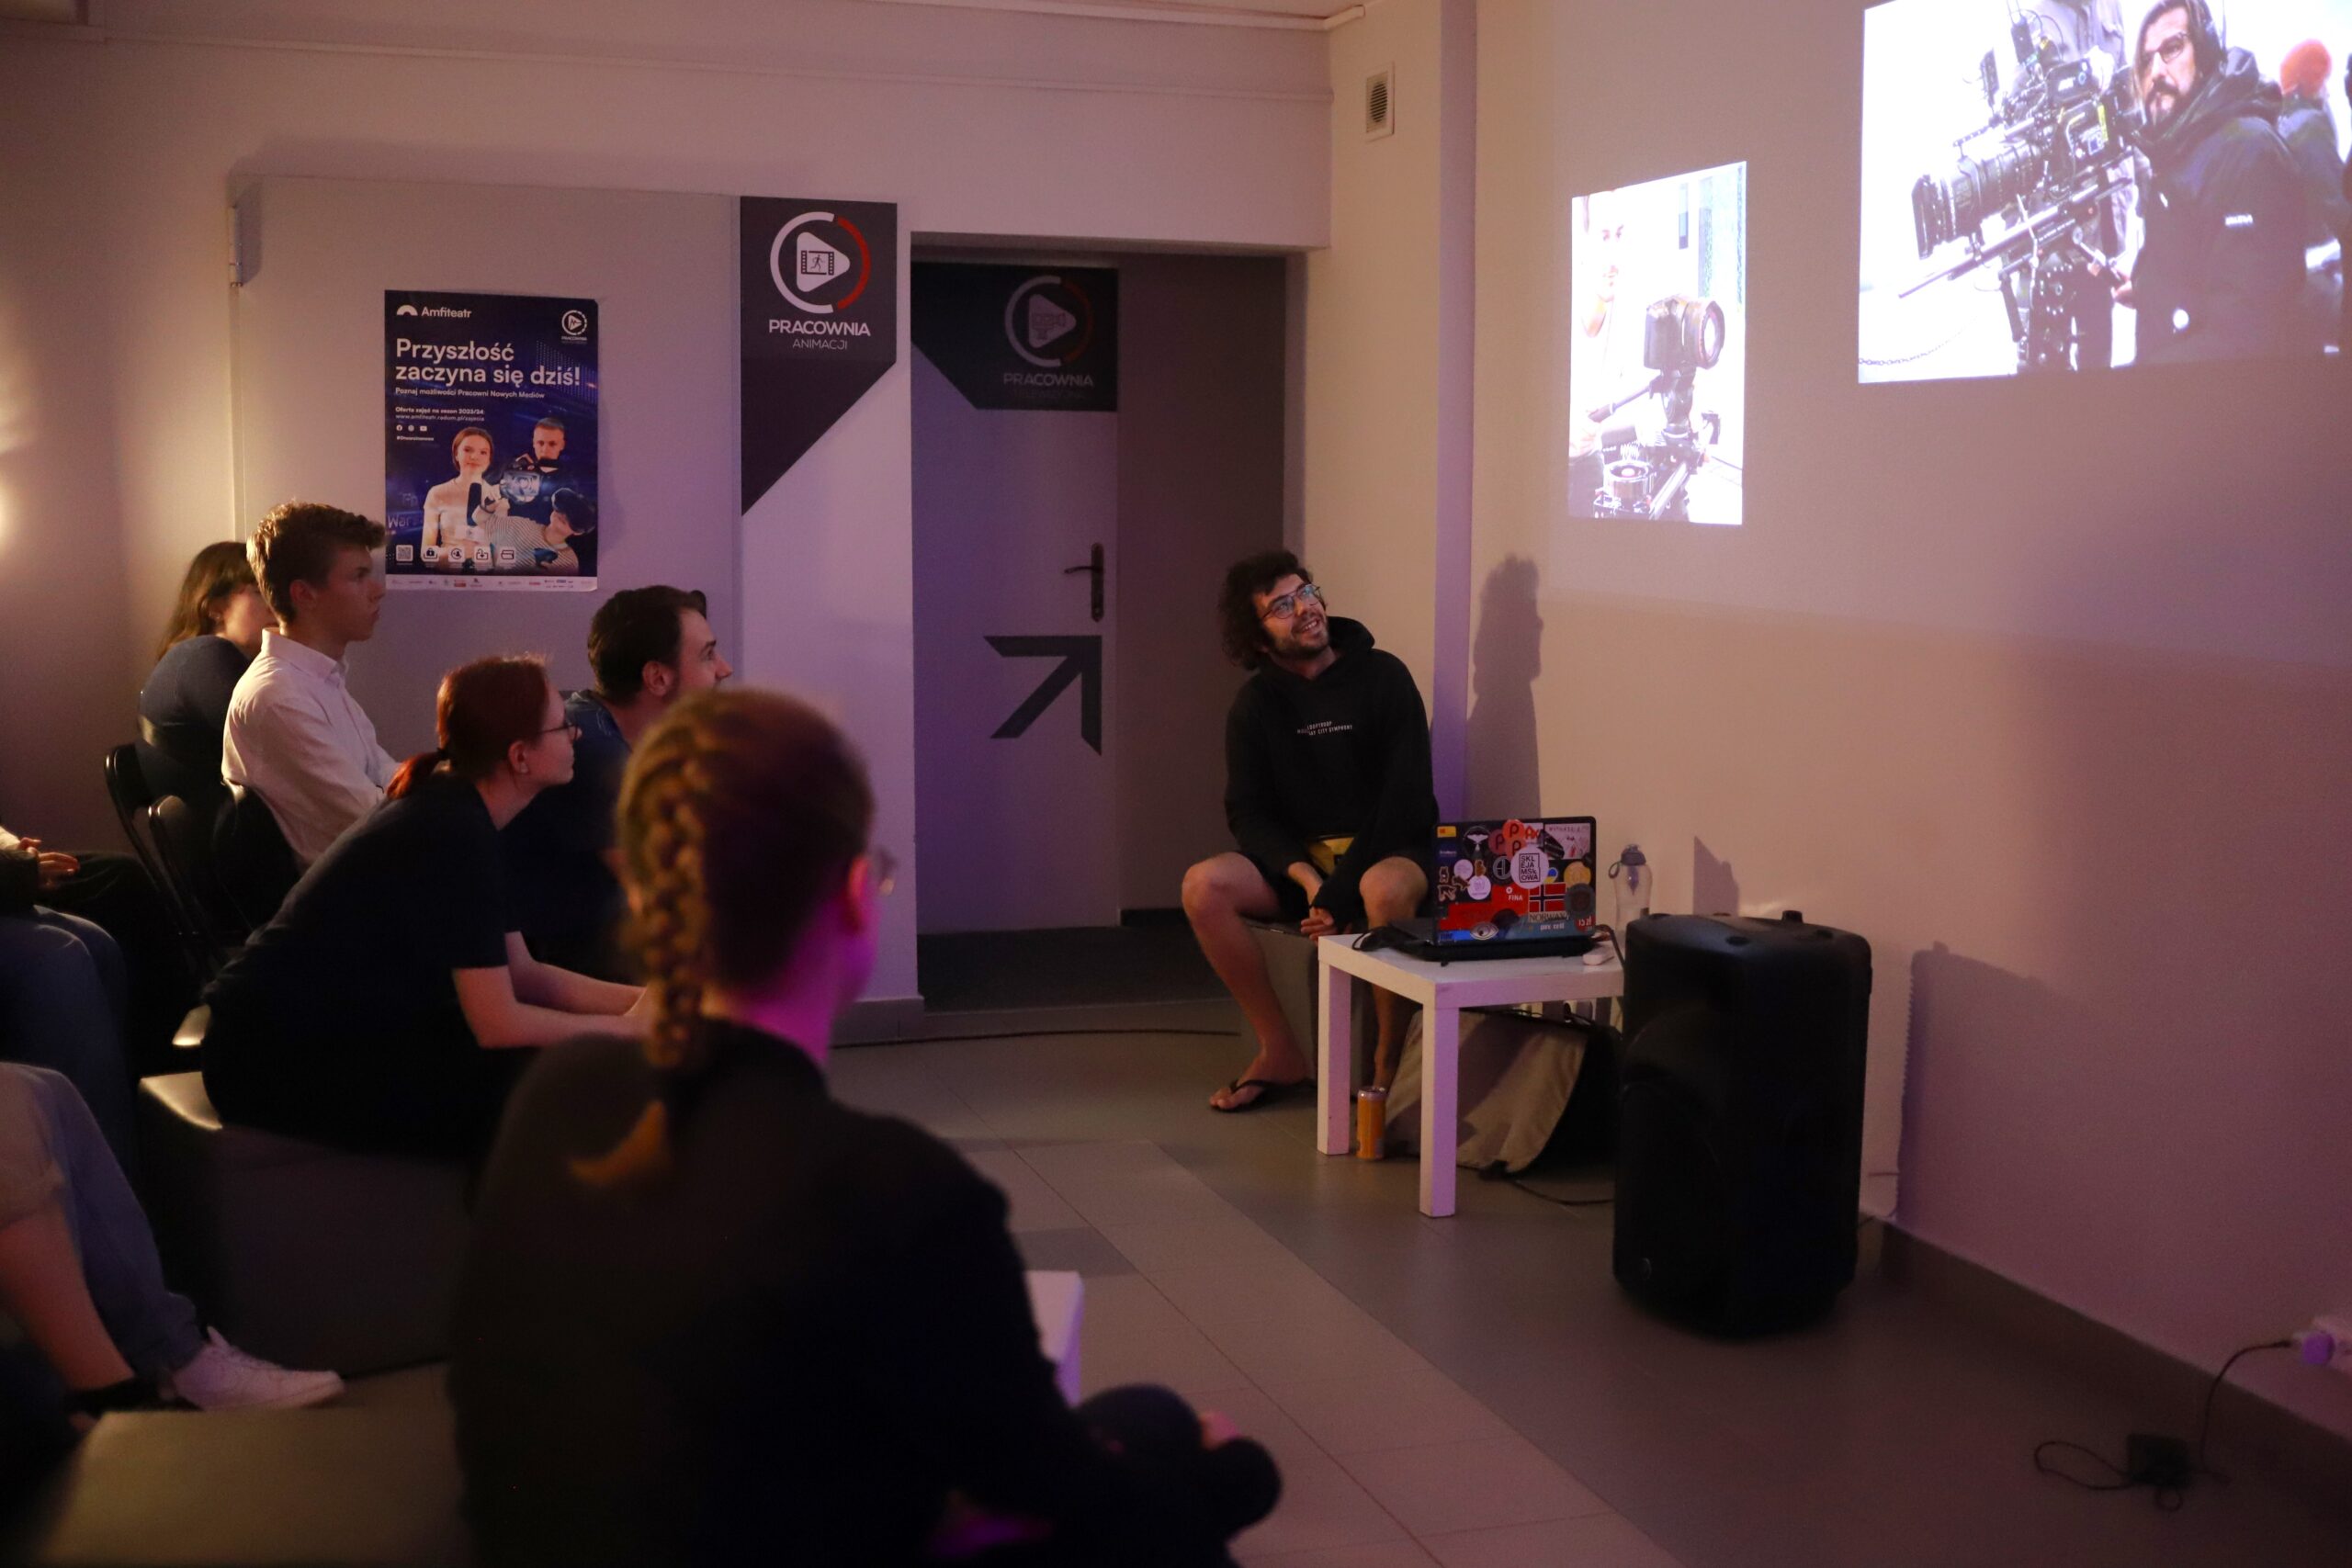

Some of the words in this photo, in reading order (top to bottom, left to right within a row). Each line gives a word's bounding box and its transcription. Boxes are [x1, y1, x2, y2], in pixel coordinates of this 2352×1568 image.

[421, 306, 472, 319] Amfiteatr
[768, 319, 871, 337] PRACOWNIA
[395, 338, 514, 364] Przyszłość
[792, 338, 848, 350] ANIMACJI
[395, 366, 486, 387] zaczyna
[493, 365, 524, 388] się
[530, 365, 581, 386] dziś!
[1003, 372, 1093, 388] PRACOWNIA
[395, 388, 418, 396] Poznaj
[491, 390, 517, 399] Nowych
